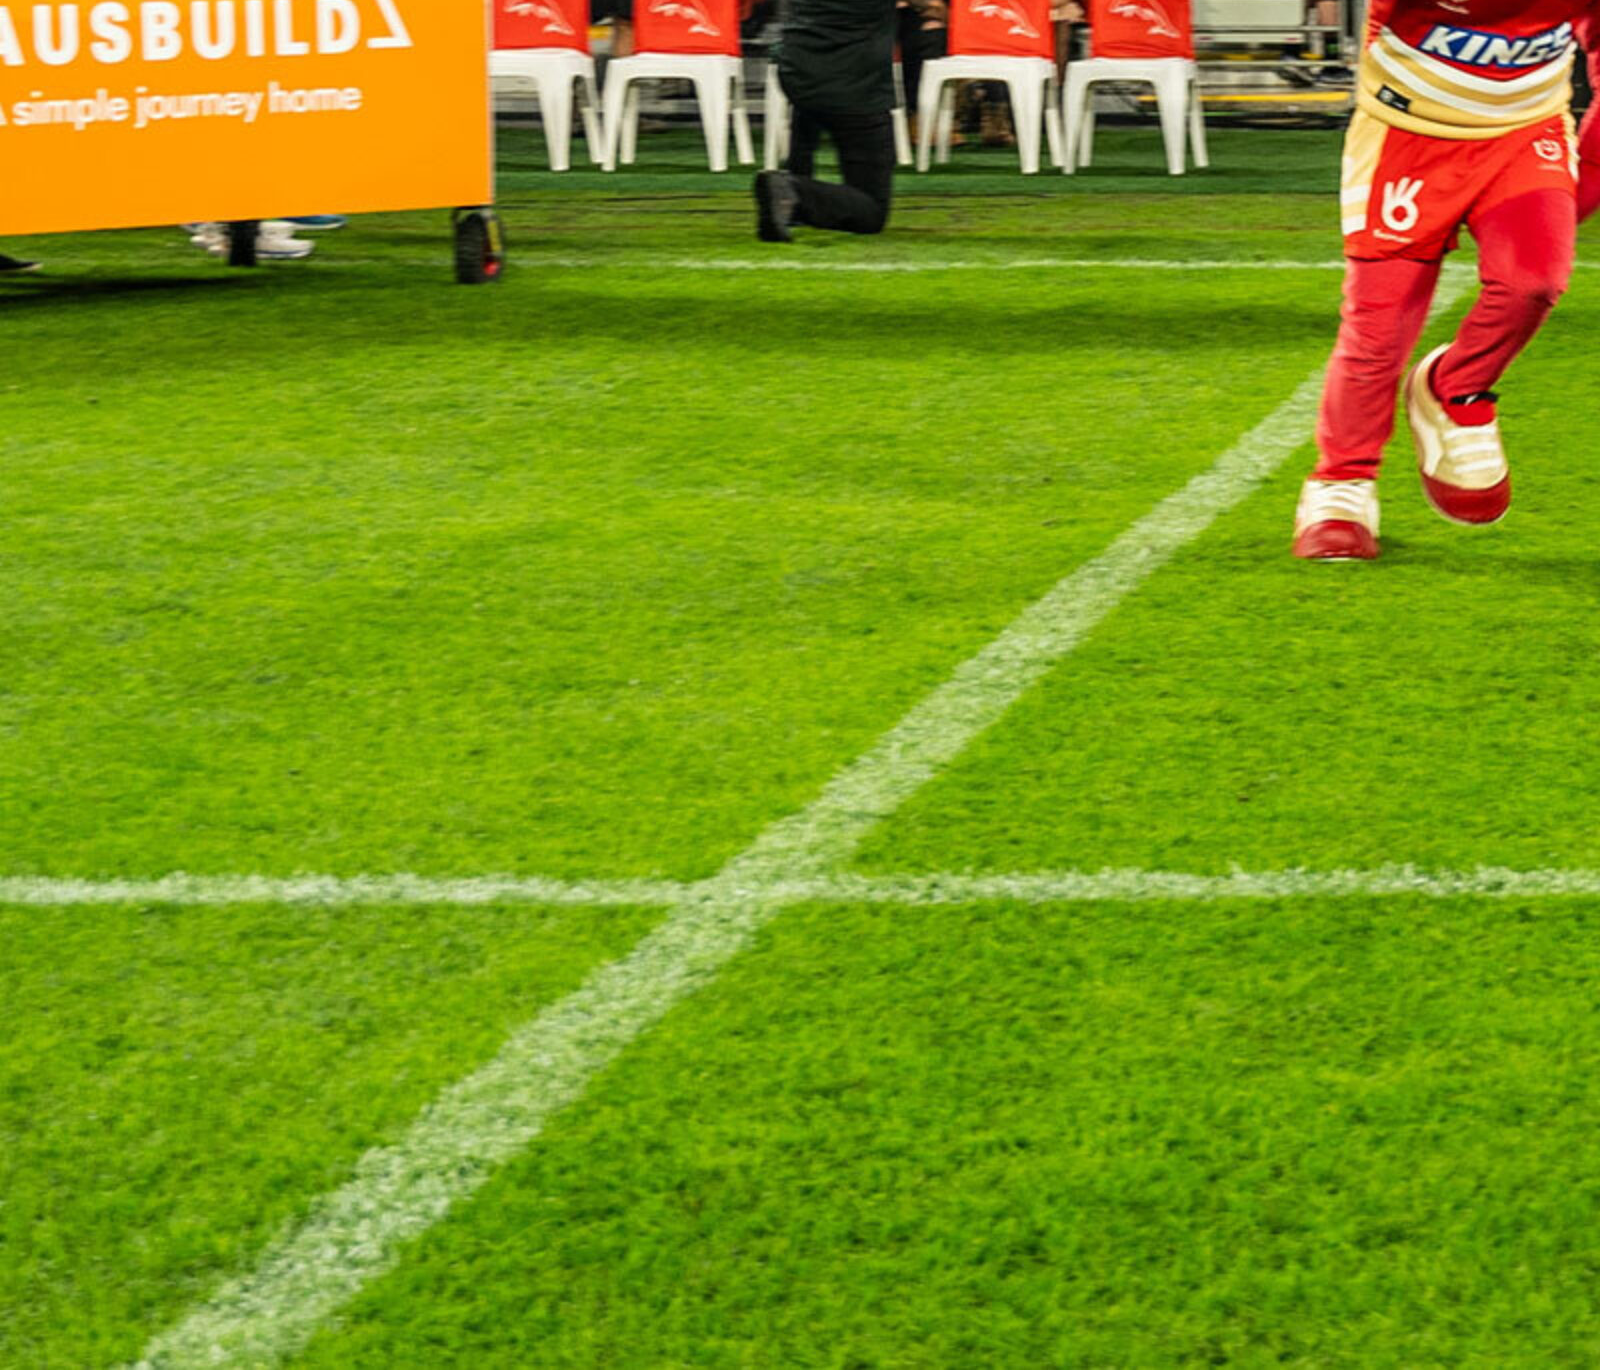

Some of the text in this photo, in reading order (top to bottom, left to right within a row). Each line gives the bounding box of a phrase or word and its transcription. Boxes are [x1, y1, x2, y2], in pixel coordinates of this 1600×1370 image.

[1420, 21, 1574, 65] KINGS
[12, 89, 130, 130] simple
[133, 86, 263, 129] journey
[268, 80, 362, 114] home
